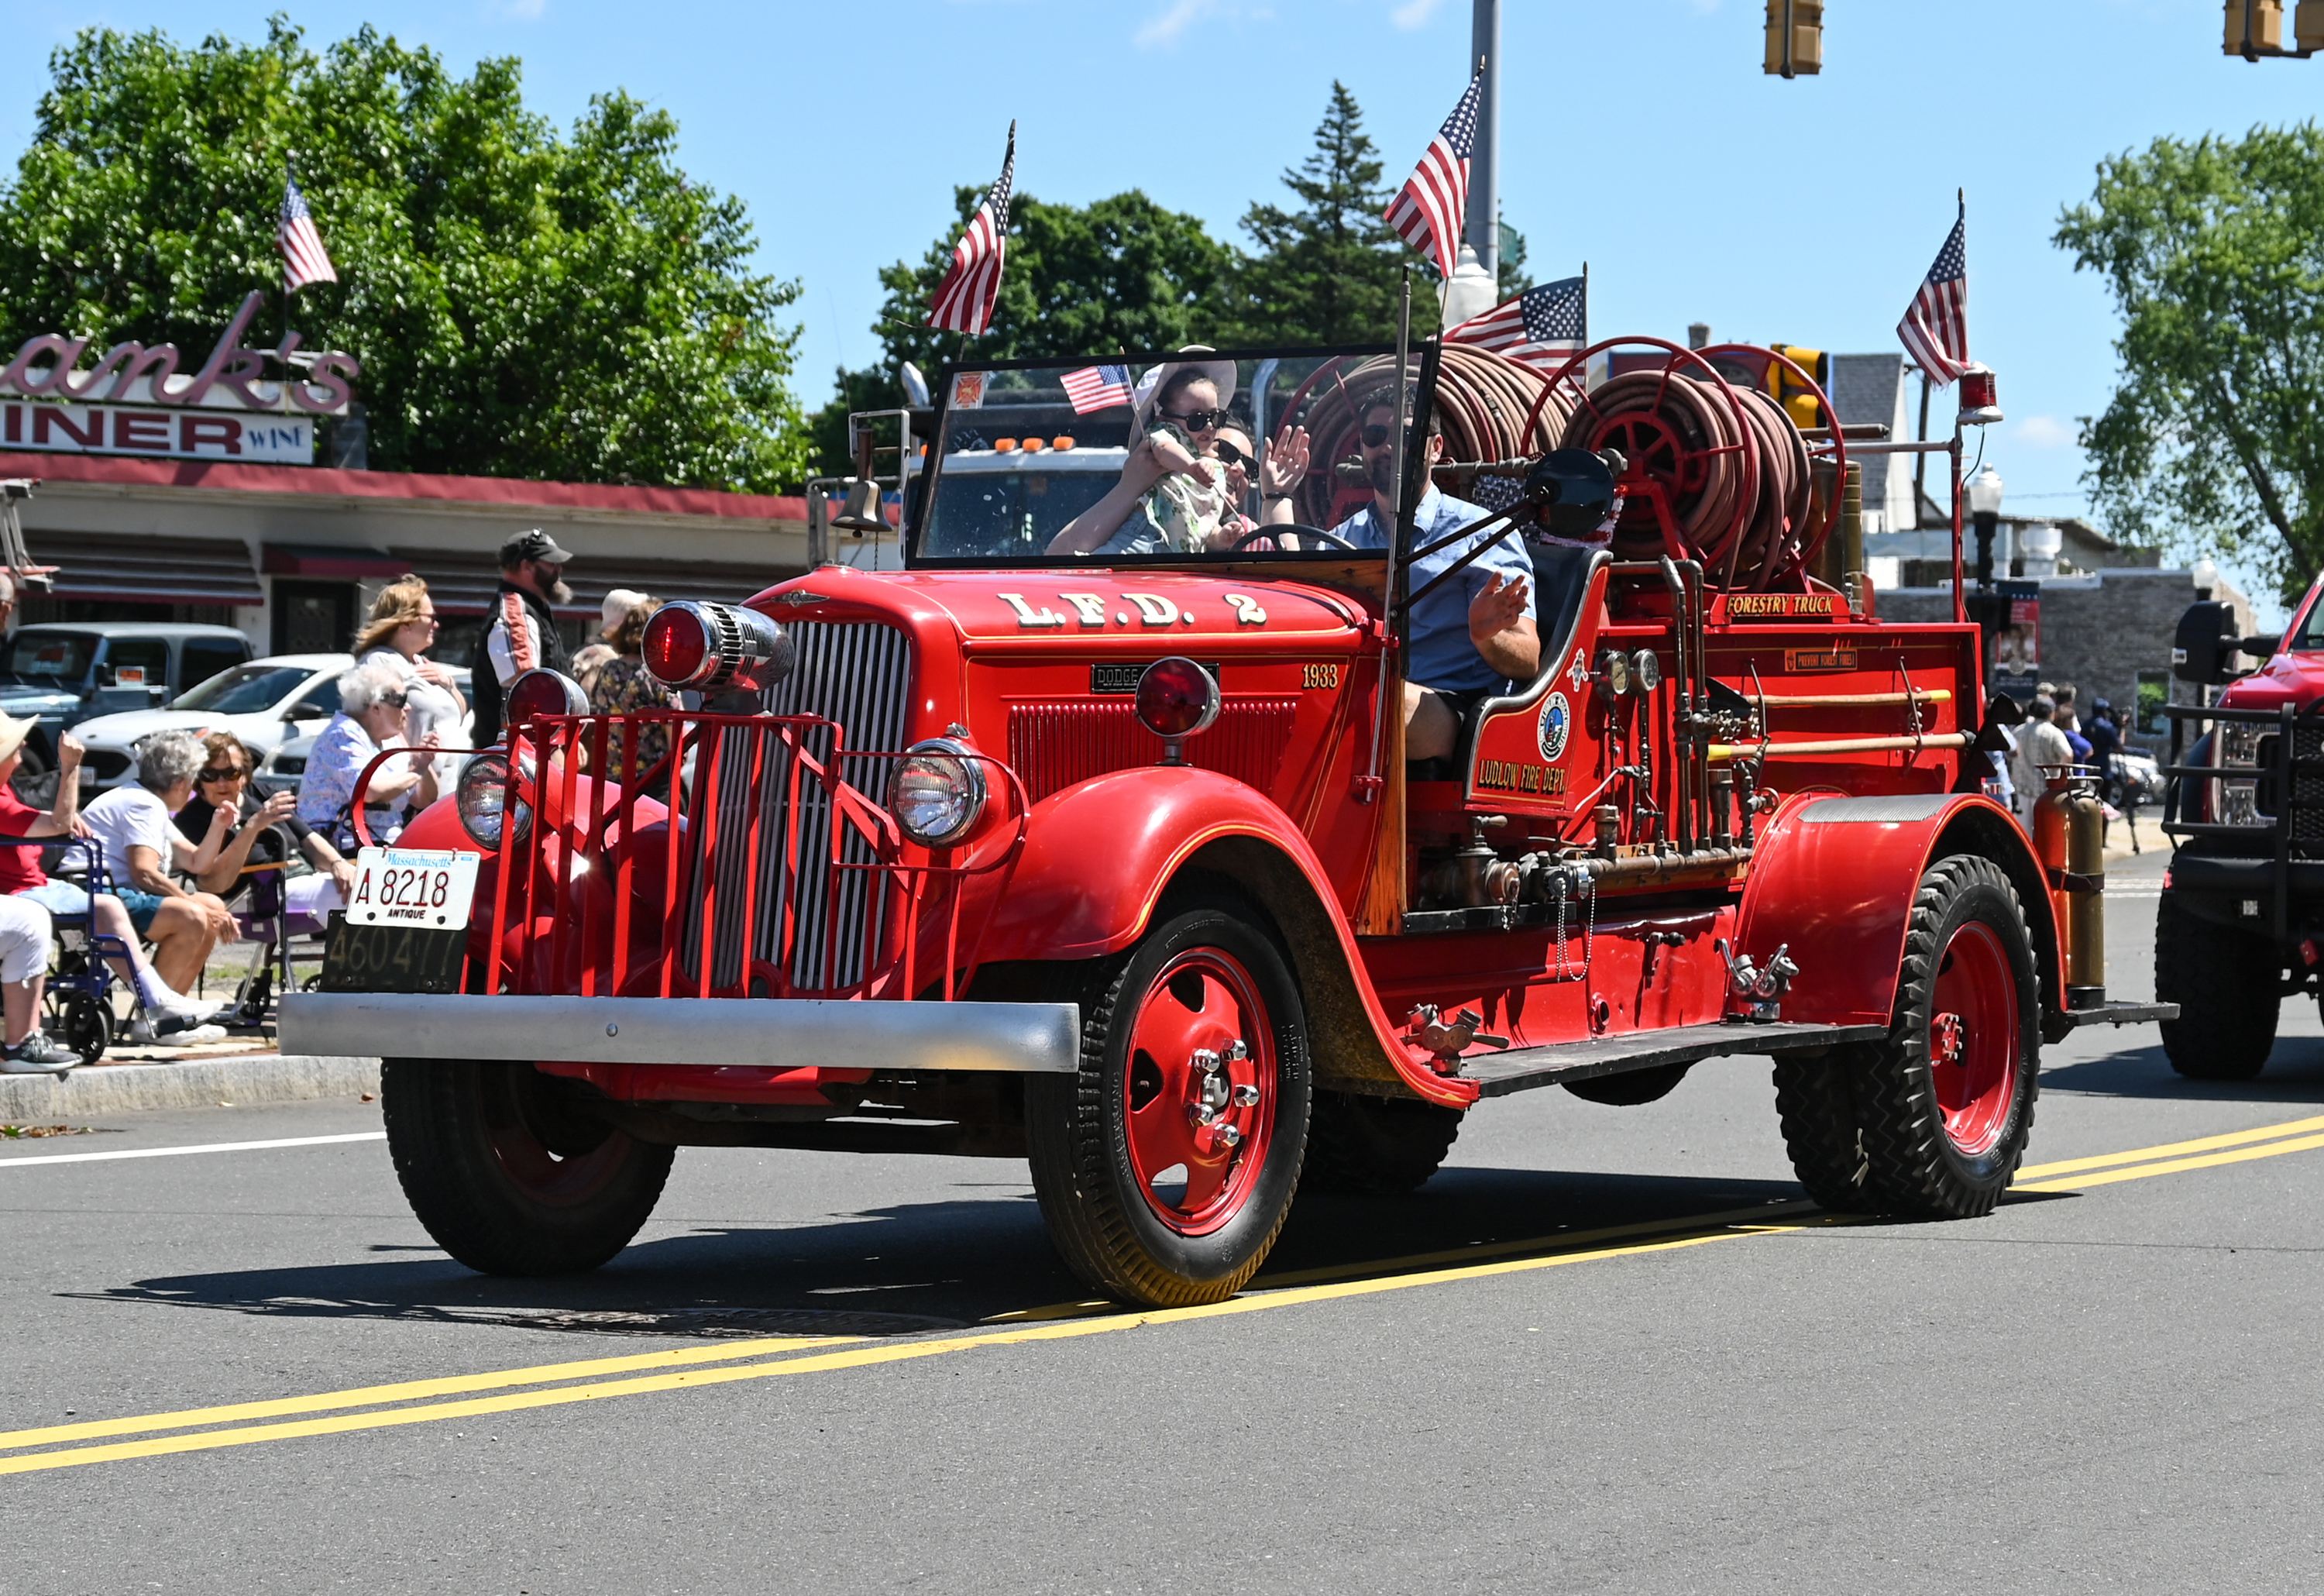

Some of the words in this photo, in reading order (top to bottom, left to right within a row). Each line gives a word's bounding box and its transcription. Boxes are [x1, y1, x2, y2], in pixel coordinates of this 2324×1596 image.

[5, 404, 242, 455] INER
[997, 593, 1195, 626] L.F.D.
[1224, 593, 1268, 625] 2
[1727, 596, 1789, 614] FORESTRY
[1794, 596, 1834, 614] TRUCK
[1097, 669, 1139, 683] DODGE
[1301, 663, 1339, 690] 1933
[1477, 759, 1518, 789] LUDLOW
[1519, 764, 1541, 792] FIRE
[1541, 767, 1565, 794] DEPT.
[386, 852, 452, 869] Massachusetts
[356, 867, 370, 905] A
[380, 869, 449, 908] 8218
[387, 908, 426, 920] ANTIQUE
